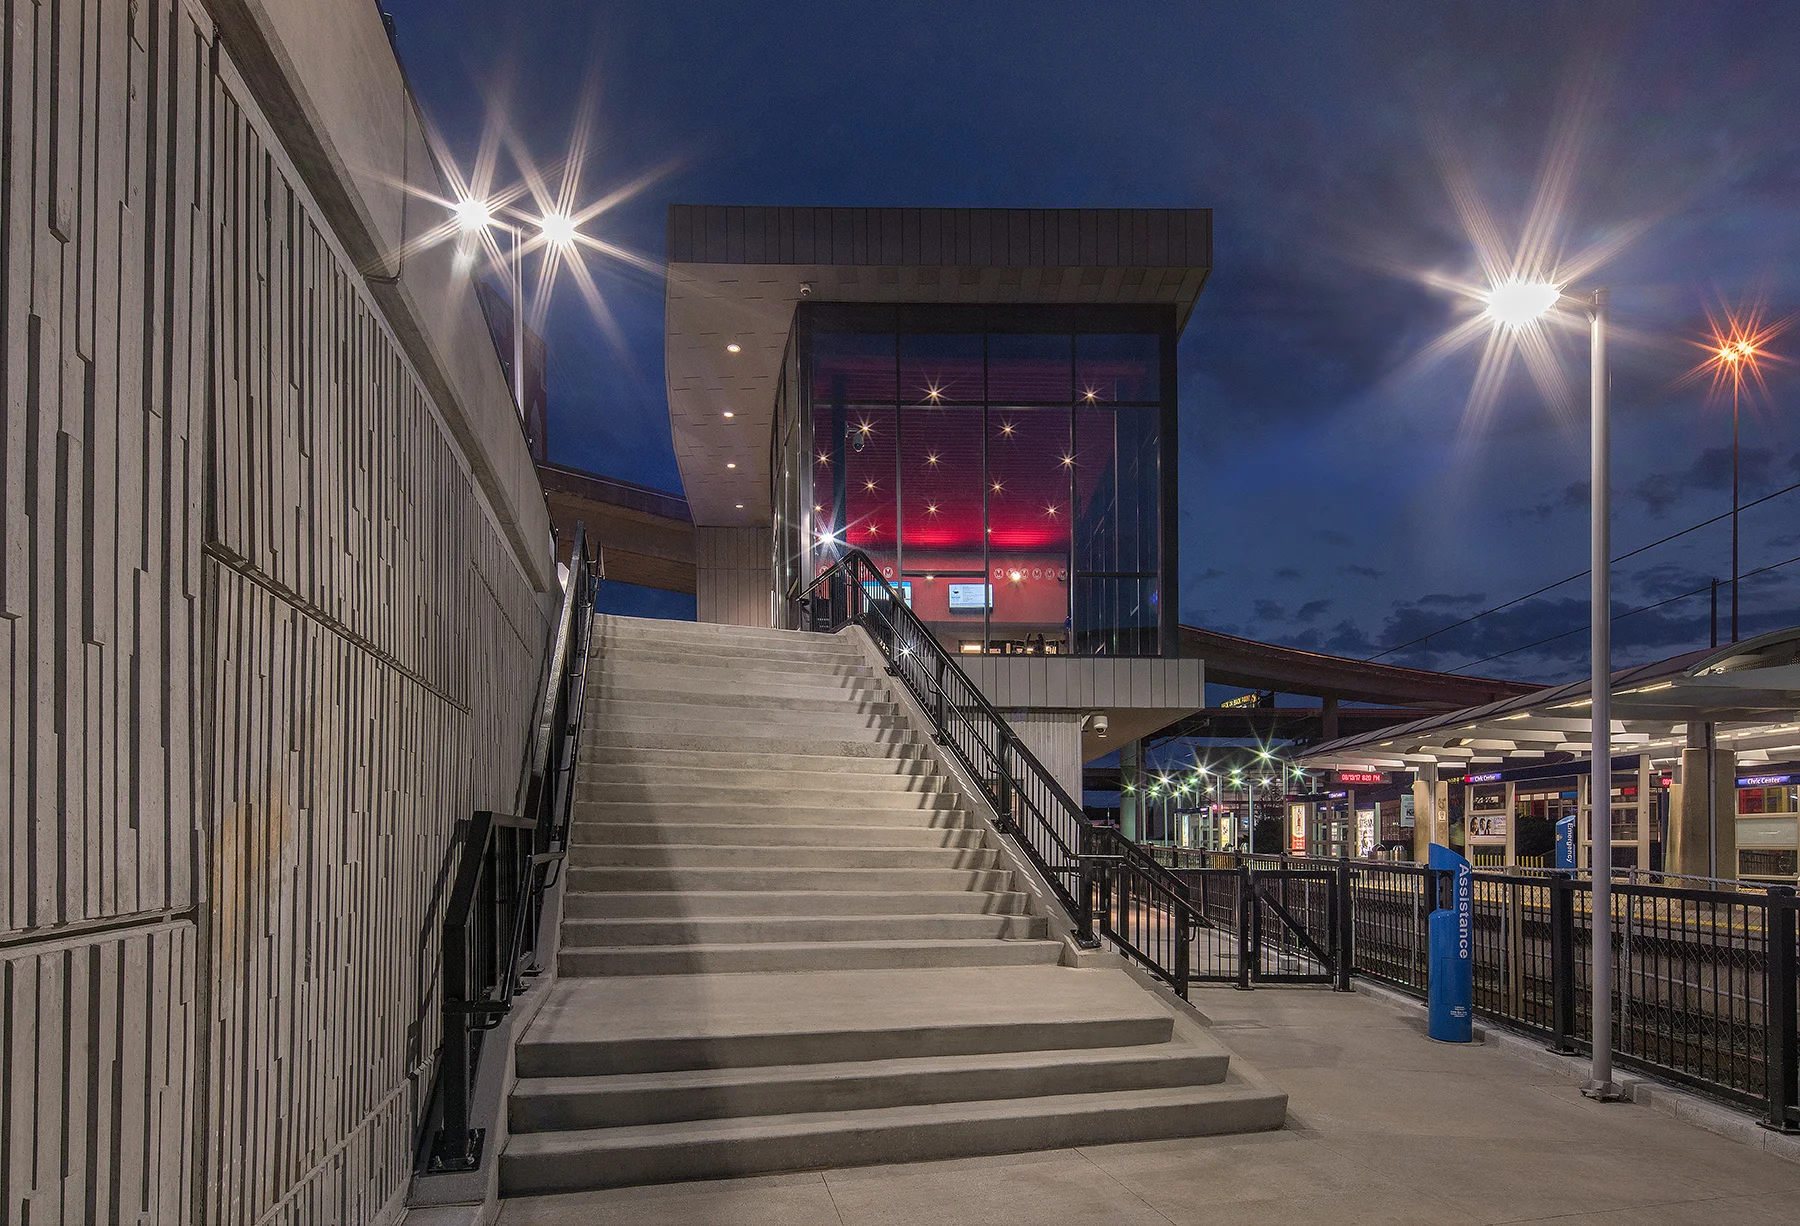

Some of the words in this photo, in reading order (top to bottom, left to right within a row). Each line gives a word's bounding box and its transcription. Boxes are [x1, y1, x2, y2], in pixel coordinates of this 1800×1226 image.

[1747, 777, 1760, 785] Civic
[1761, 776, 1781, 784] Center
[1565, 823, 1574, 863] Emergency
[1458, 863, 1470, 959] Assistance
